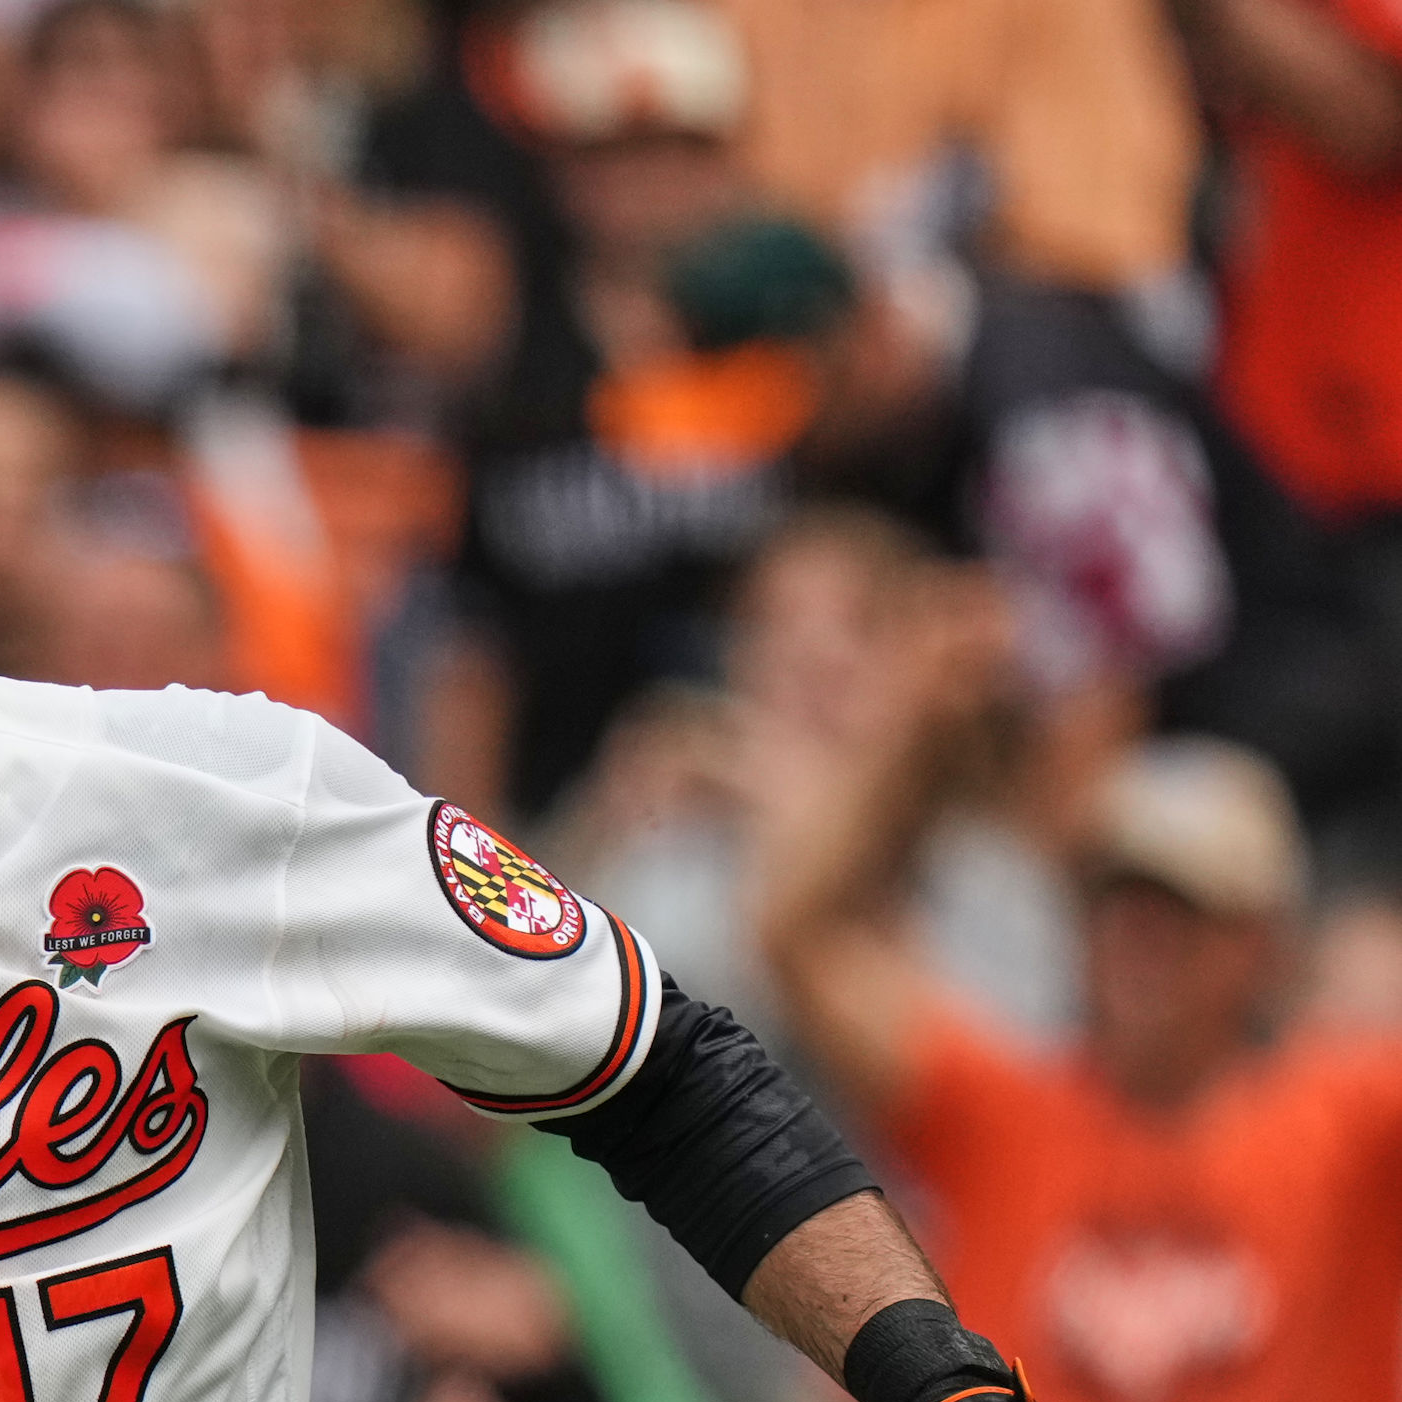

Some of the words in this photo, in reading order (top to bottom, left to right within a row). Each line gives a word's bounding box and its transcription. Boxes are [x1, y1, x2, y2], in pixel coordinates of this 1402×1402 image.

[435, 805, 486, 925] BALTIMORE
[48, 939, 75, 951] LEST
[79, 935, 96, 947] WE
[101, 929, 145, 943] FORGET
